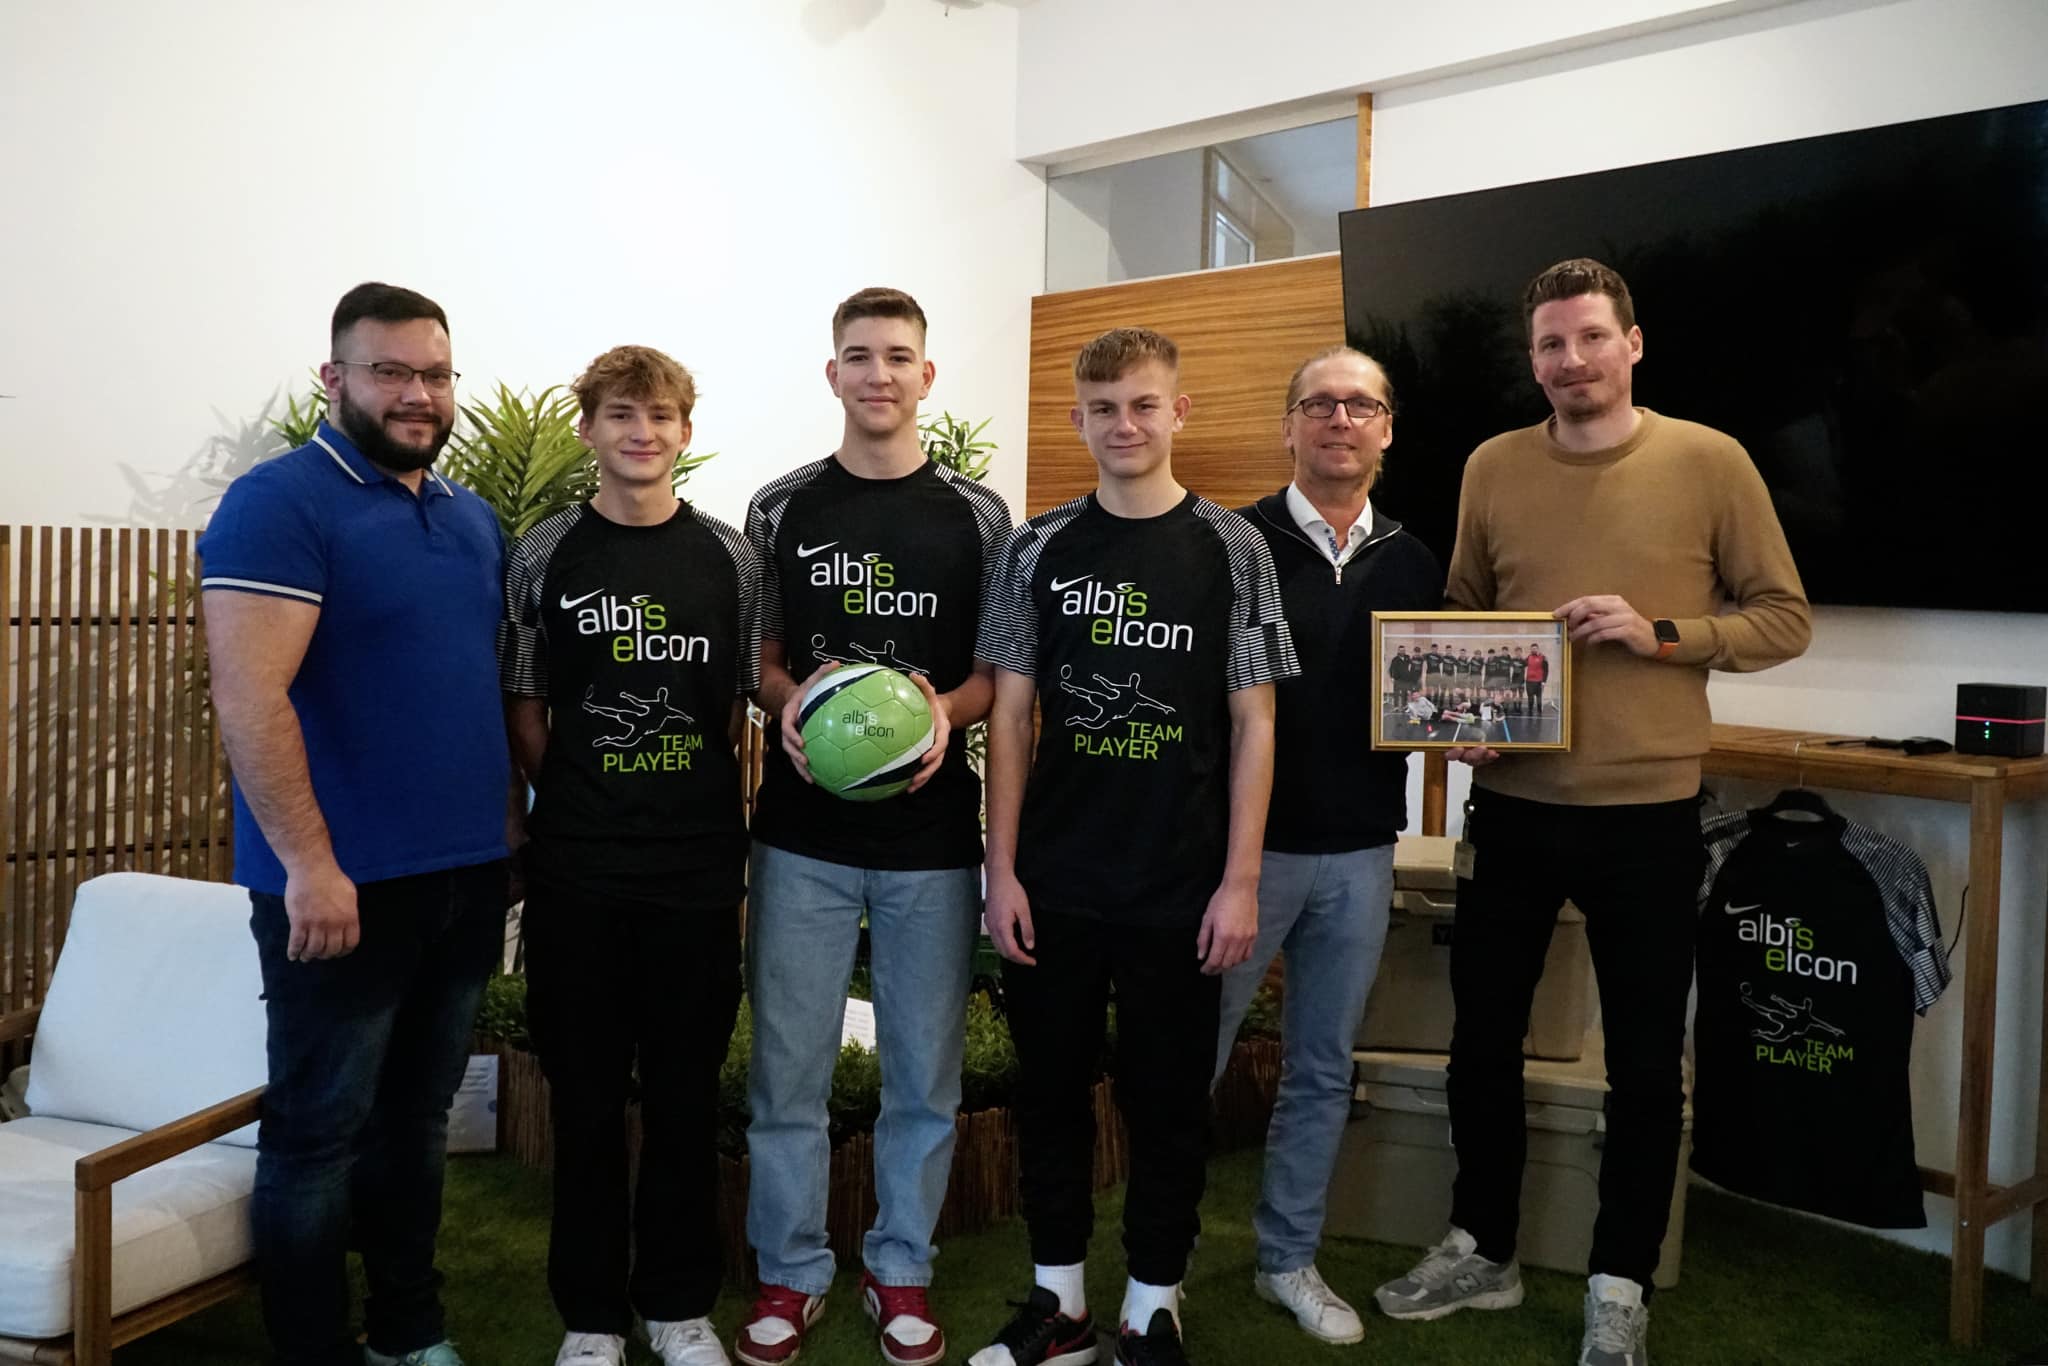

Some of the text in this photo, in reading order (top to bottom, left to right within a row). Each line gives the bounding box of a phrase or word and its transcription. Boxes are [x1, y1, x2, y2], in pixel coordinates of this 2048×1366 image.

[810, 552, 895, 587] albis
[843, 586, 938, 618] elcon
[1062, 581, 1148, 617] albis
[577, 595, 667, 635] albis
[612, 630, 710, 663] elcon
[1091, 614, 1194, 652] elcon
[842, 710, 878, 726] albis
[855, 725, 895, 737] elcon
[1127, 721, 1183, 743] TEAM
[658, 734, 703, 752] TEAM
[1074, 733, 1159, 761] PLAYER
[603, 751, 692, 773] PLAYER
[1738, 913, 1814, 951] albis
[1765, 948, 1858, 985] elcon
[1756, 1045, 1832, 1074] PLAYER
[1804, 1038, 1854, 1061] TEAM
